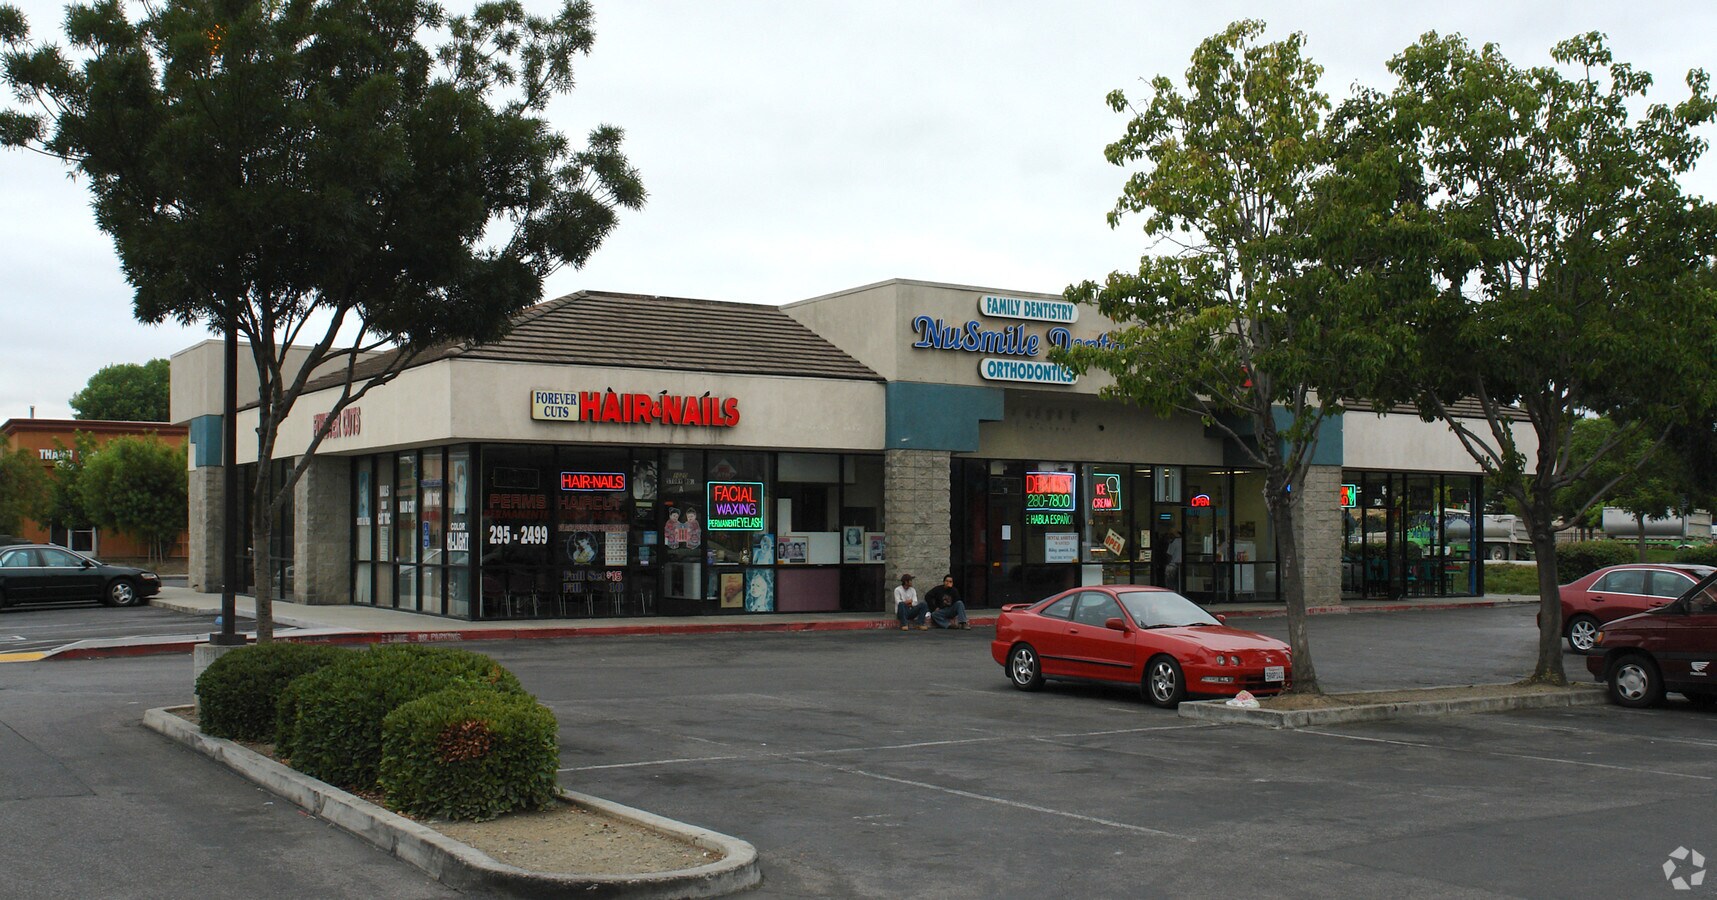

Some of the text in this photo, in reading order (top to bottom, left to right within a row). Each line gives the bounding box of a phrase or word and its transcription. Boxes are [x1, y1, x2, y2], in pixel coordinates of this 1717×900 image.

[987, 297, 1073, 320] FAMILY DENTISTRY
[914, 315, 1040, 356] NuSmile
[987, 361, 1073, 382] ORTHODONTICS
[536, 391, 577, 405] FOREVER
[544, 406, 569, 418] CUTS
[343, 406, 361, 437] CUTS
[562, 474, 624, 489] HAIR-NAILS
[714, 485, 757, 502] FACIAL
[1095, 483, 1106, 495] ICE
[489, 493, 546, 509] PERMS
[1027, 494, 1071, 508] 280-7800
[1092, 498, 1112, 509] CREAM
[1191, 496, 1210, 507] OPEN
[716, 503, 756, 515] WAXING
[450, 522, 466, 531] COLOR
[708, 519, 737, 528] PERMANENT
[1030, 514, 1050, 525] HABLA
[489, 525, 511, 545] 295
[520, 525, 548, 545] 2499
[1105, 535, 1121, 553] OPEN
[606, 570, 623, 582] $15
